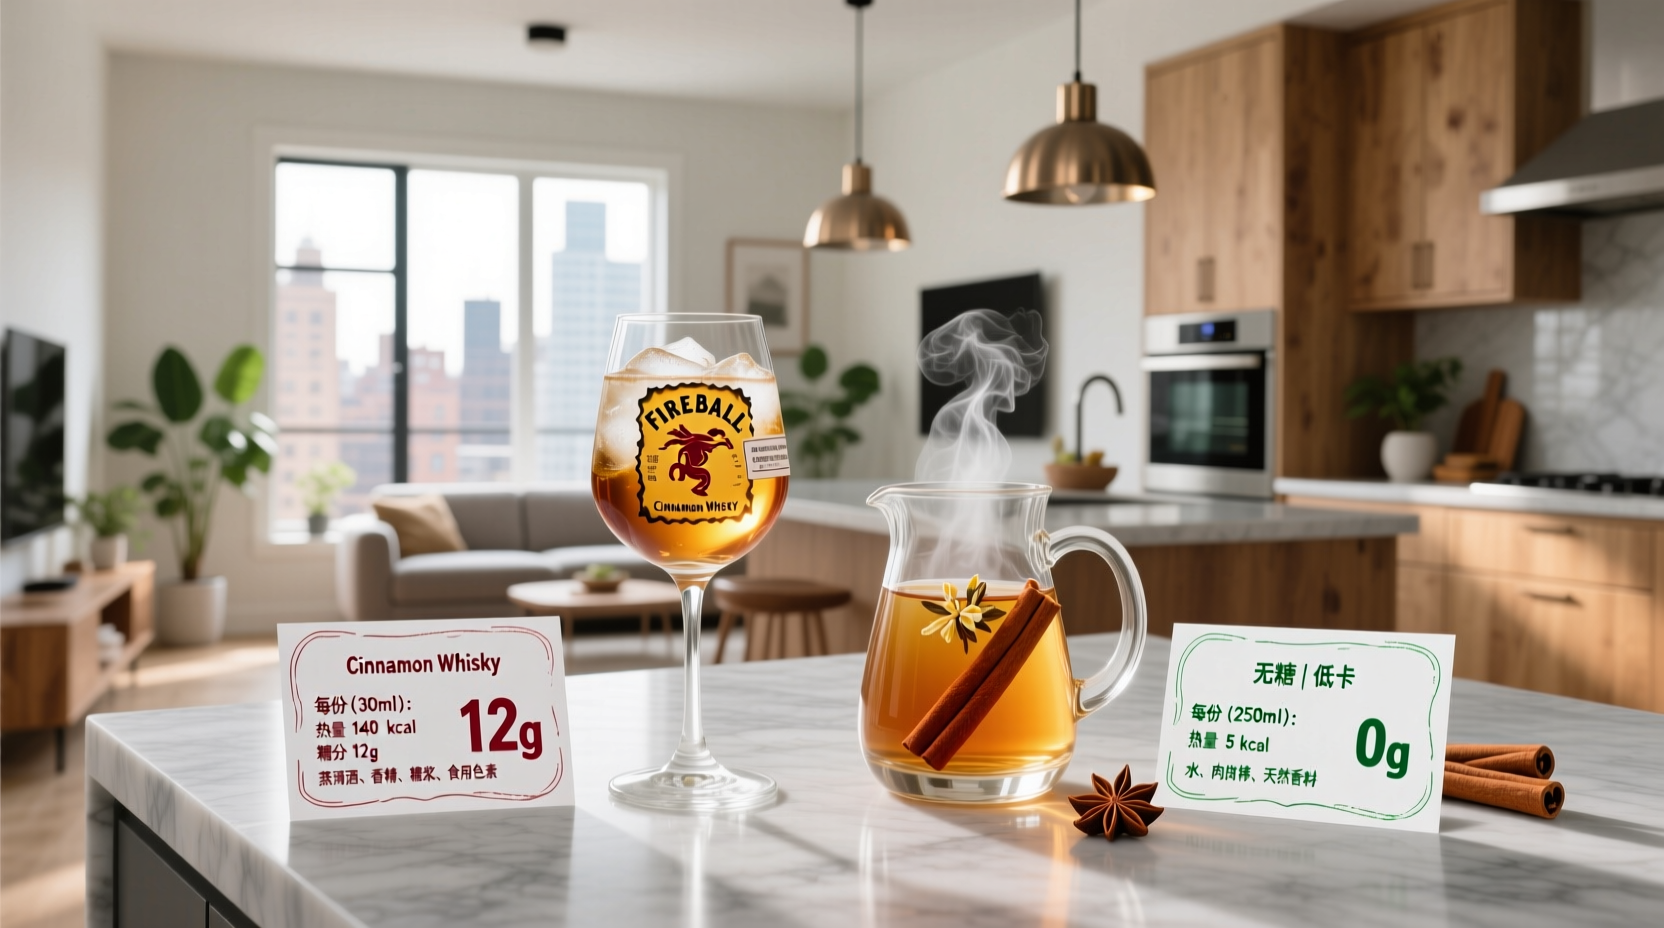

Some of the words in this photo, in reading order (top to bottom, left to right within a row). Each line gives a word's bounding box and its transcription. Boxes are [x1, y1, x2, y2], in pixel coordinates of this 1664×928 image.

[645, 394, 746, 433] FIREBALL
[347, 656, 433, 674] Cinnamon
[437, 652, 500, 676] Whisky
[1253, 662, 1297, 686] 无糖
[1313, 664, 1355, 689] 低卡
[1191, 703, 1222, 722] 每份
[1228, 706, 1296, 727] (250ml):
[316, 721, 345, 738] 热量
[352, 720, 378, 736] 140
[387, 719, 416, 734] kcal
[460, 697, 543, 760] 12g
[1188, 729, 1218, 749] 热量
[1226, 734, 1235, 749] 5
[1240, 735, 1269, 752] kcal
[353, 743, 378, 762] 12g
[1356, 718, 1410, 779] 0g
